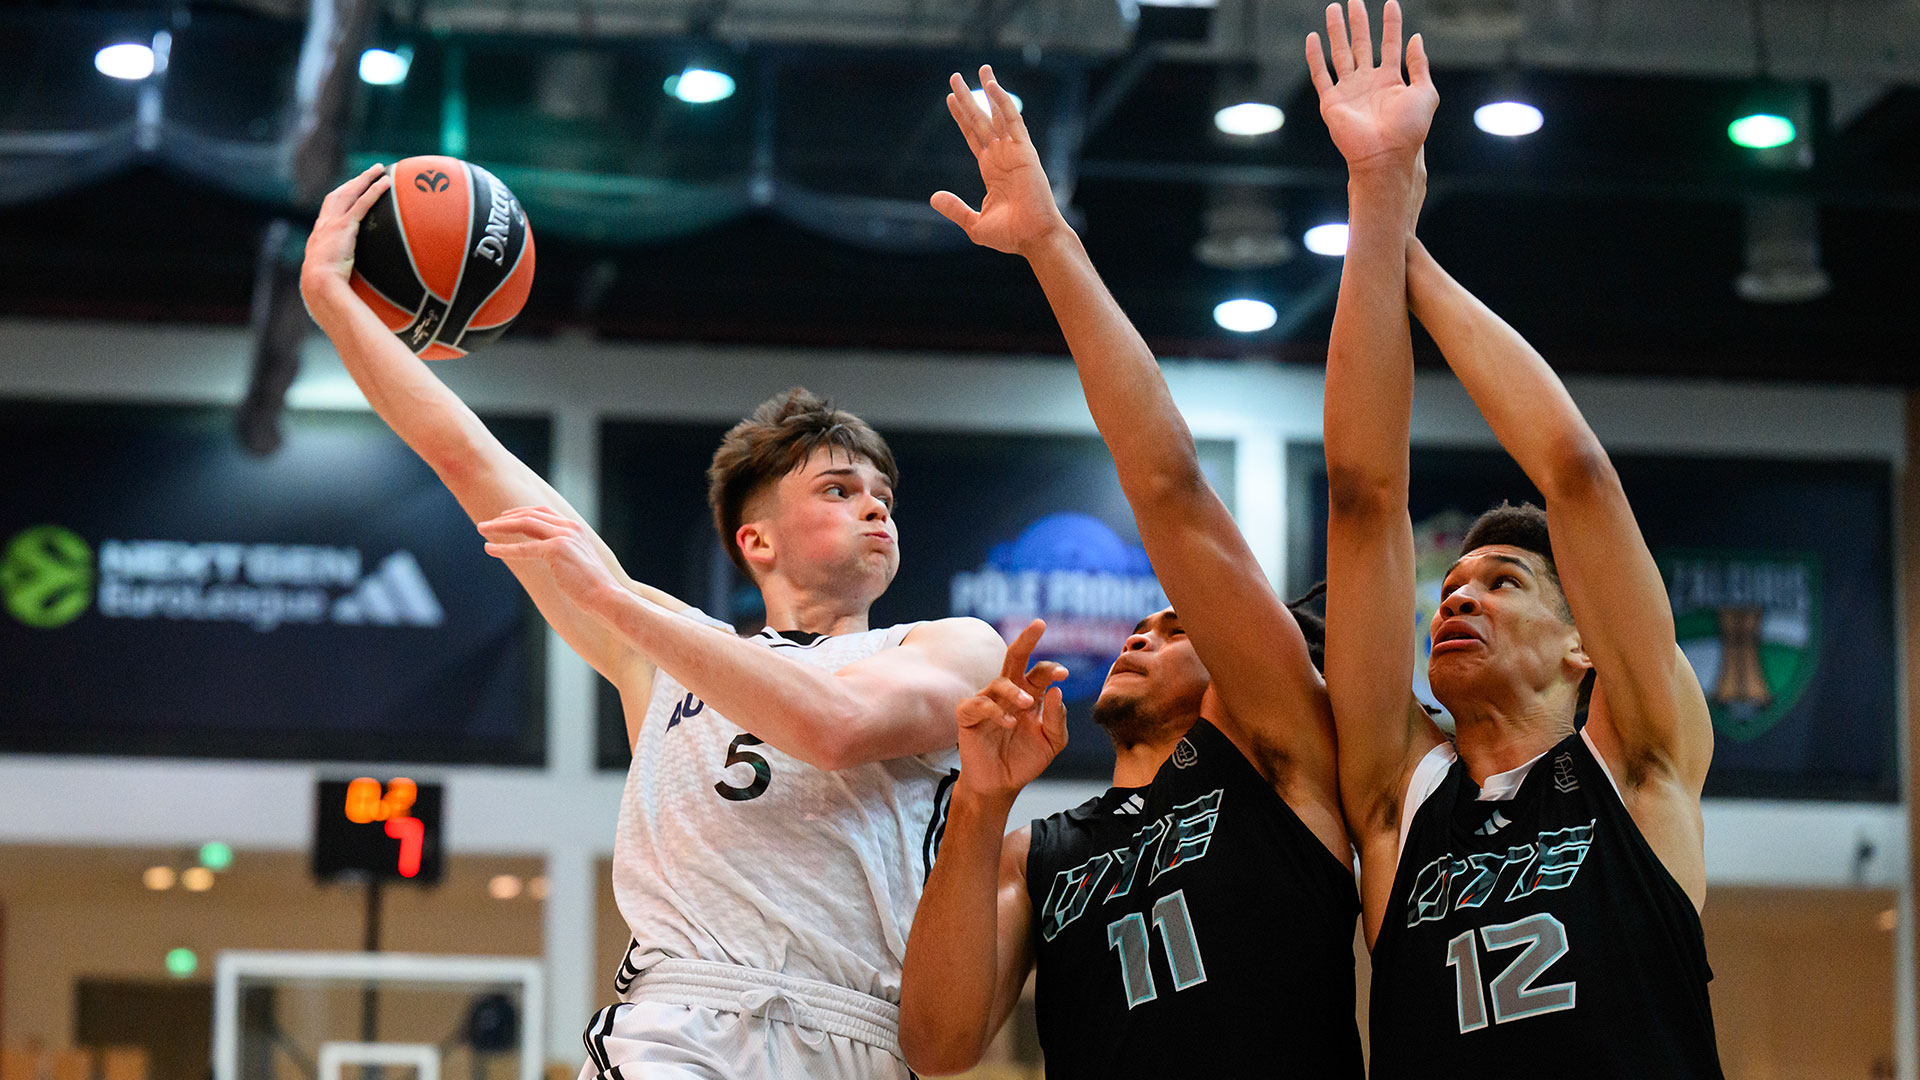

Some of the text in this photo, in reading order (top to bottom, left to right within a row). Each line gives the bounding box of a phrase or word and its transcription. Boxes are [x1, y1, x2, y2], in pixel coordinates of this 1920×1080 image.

[100, 540, 362, 585] NEXT GEN
[713, 733, 772, 802] 5
[384, 817, 424, 878] 7
[1042, 789, 1224, 942] OTE
[1407, 818, 1596, 928] OTE
[1107, 889, 1207, 1010] 11
[1446, 913, 1576, 1034] 12
